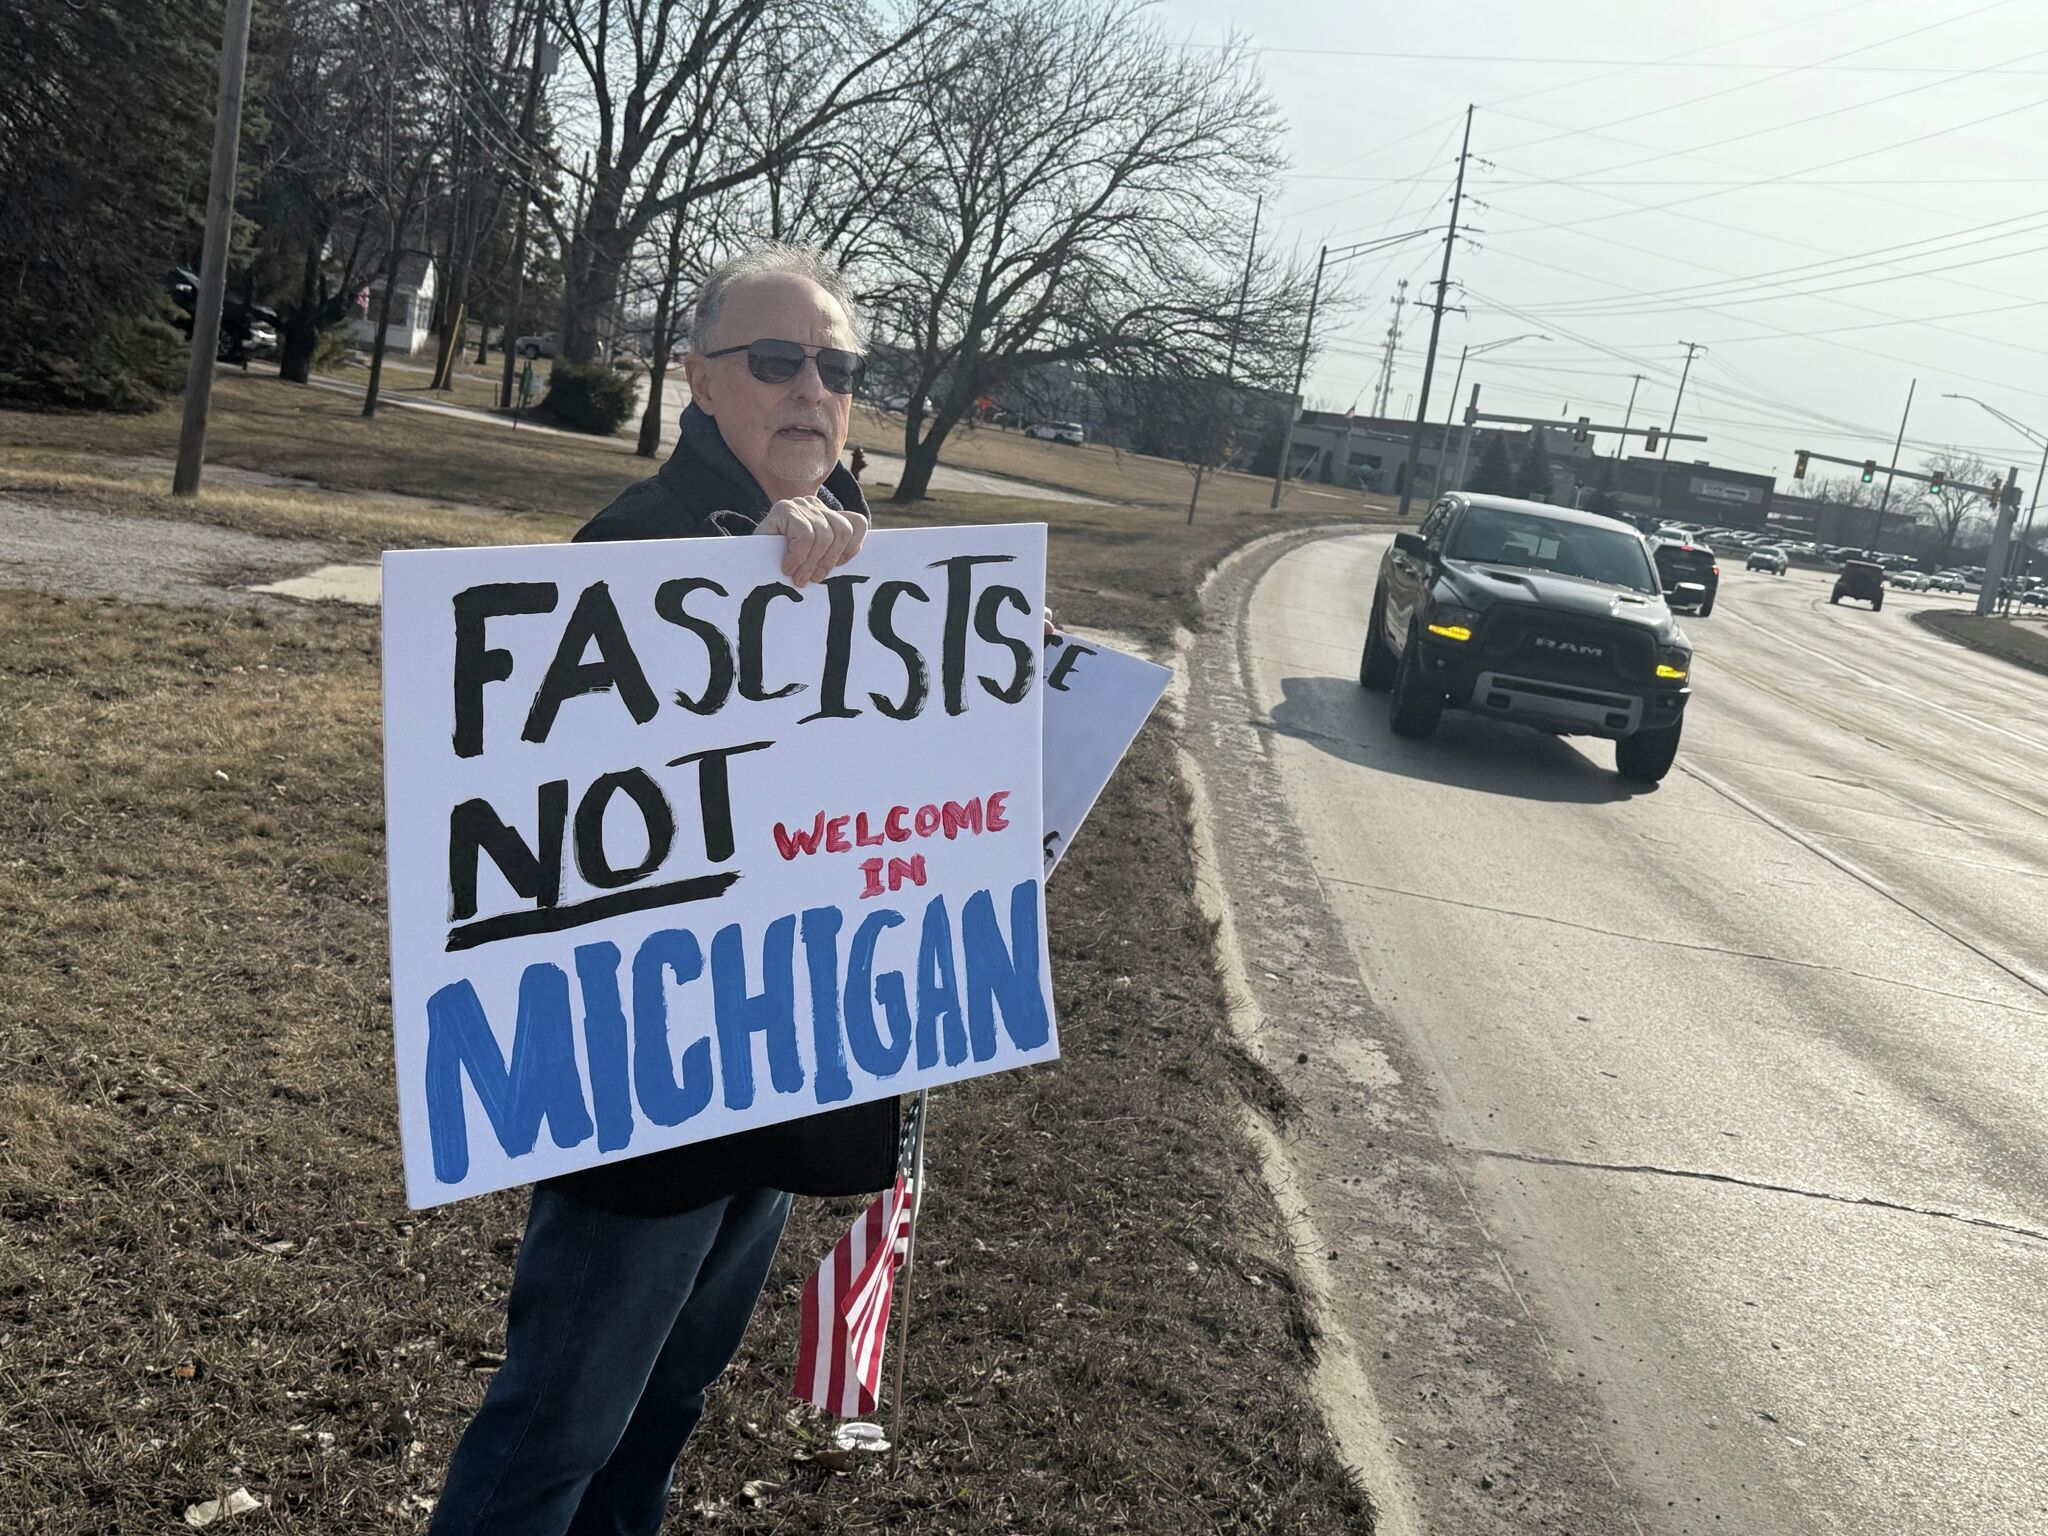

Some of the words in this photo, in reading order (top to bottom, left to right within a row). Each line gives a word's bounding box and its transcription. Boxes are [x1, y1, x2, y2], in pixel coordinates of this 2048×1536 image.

[451, 554, 1035, 758] FASCISTS
[1536, 637, 1602, 656] RAM
[446, 740, 776, 922] NOT
[772, 790, 1011, 863] WELCOME
[858, 853, 927, 899] IN
[424, 878, 1051, 1186] MICHIGAN
